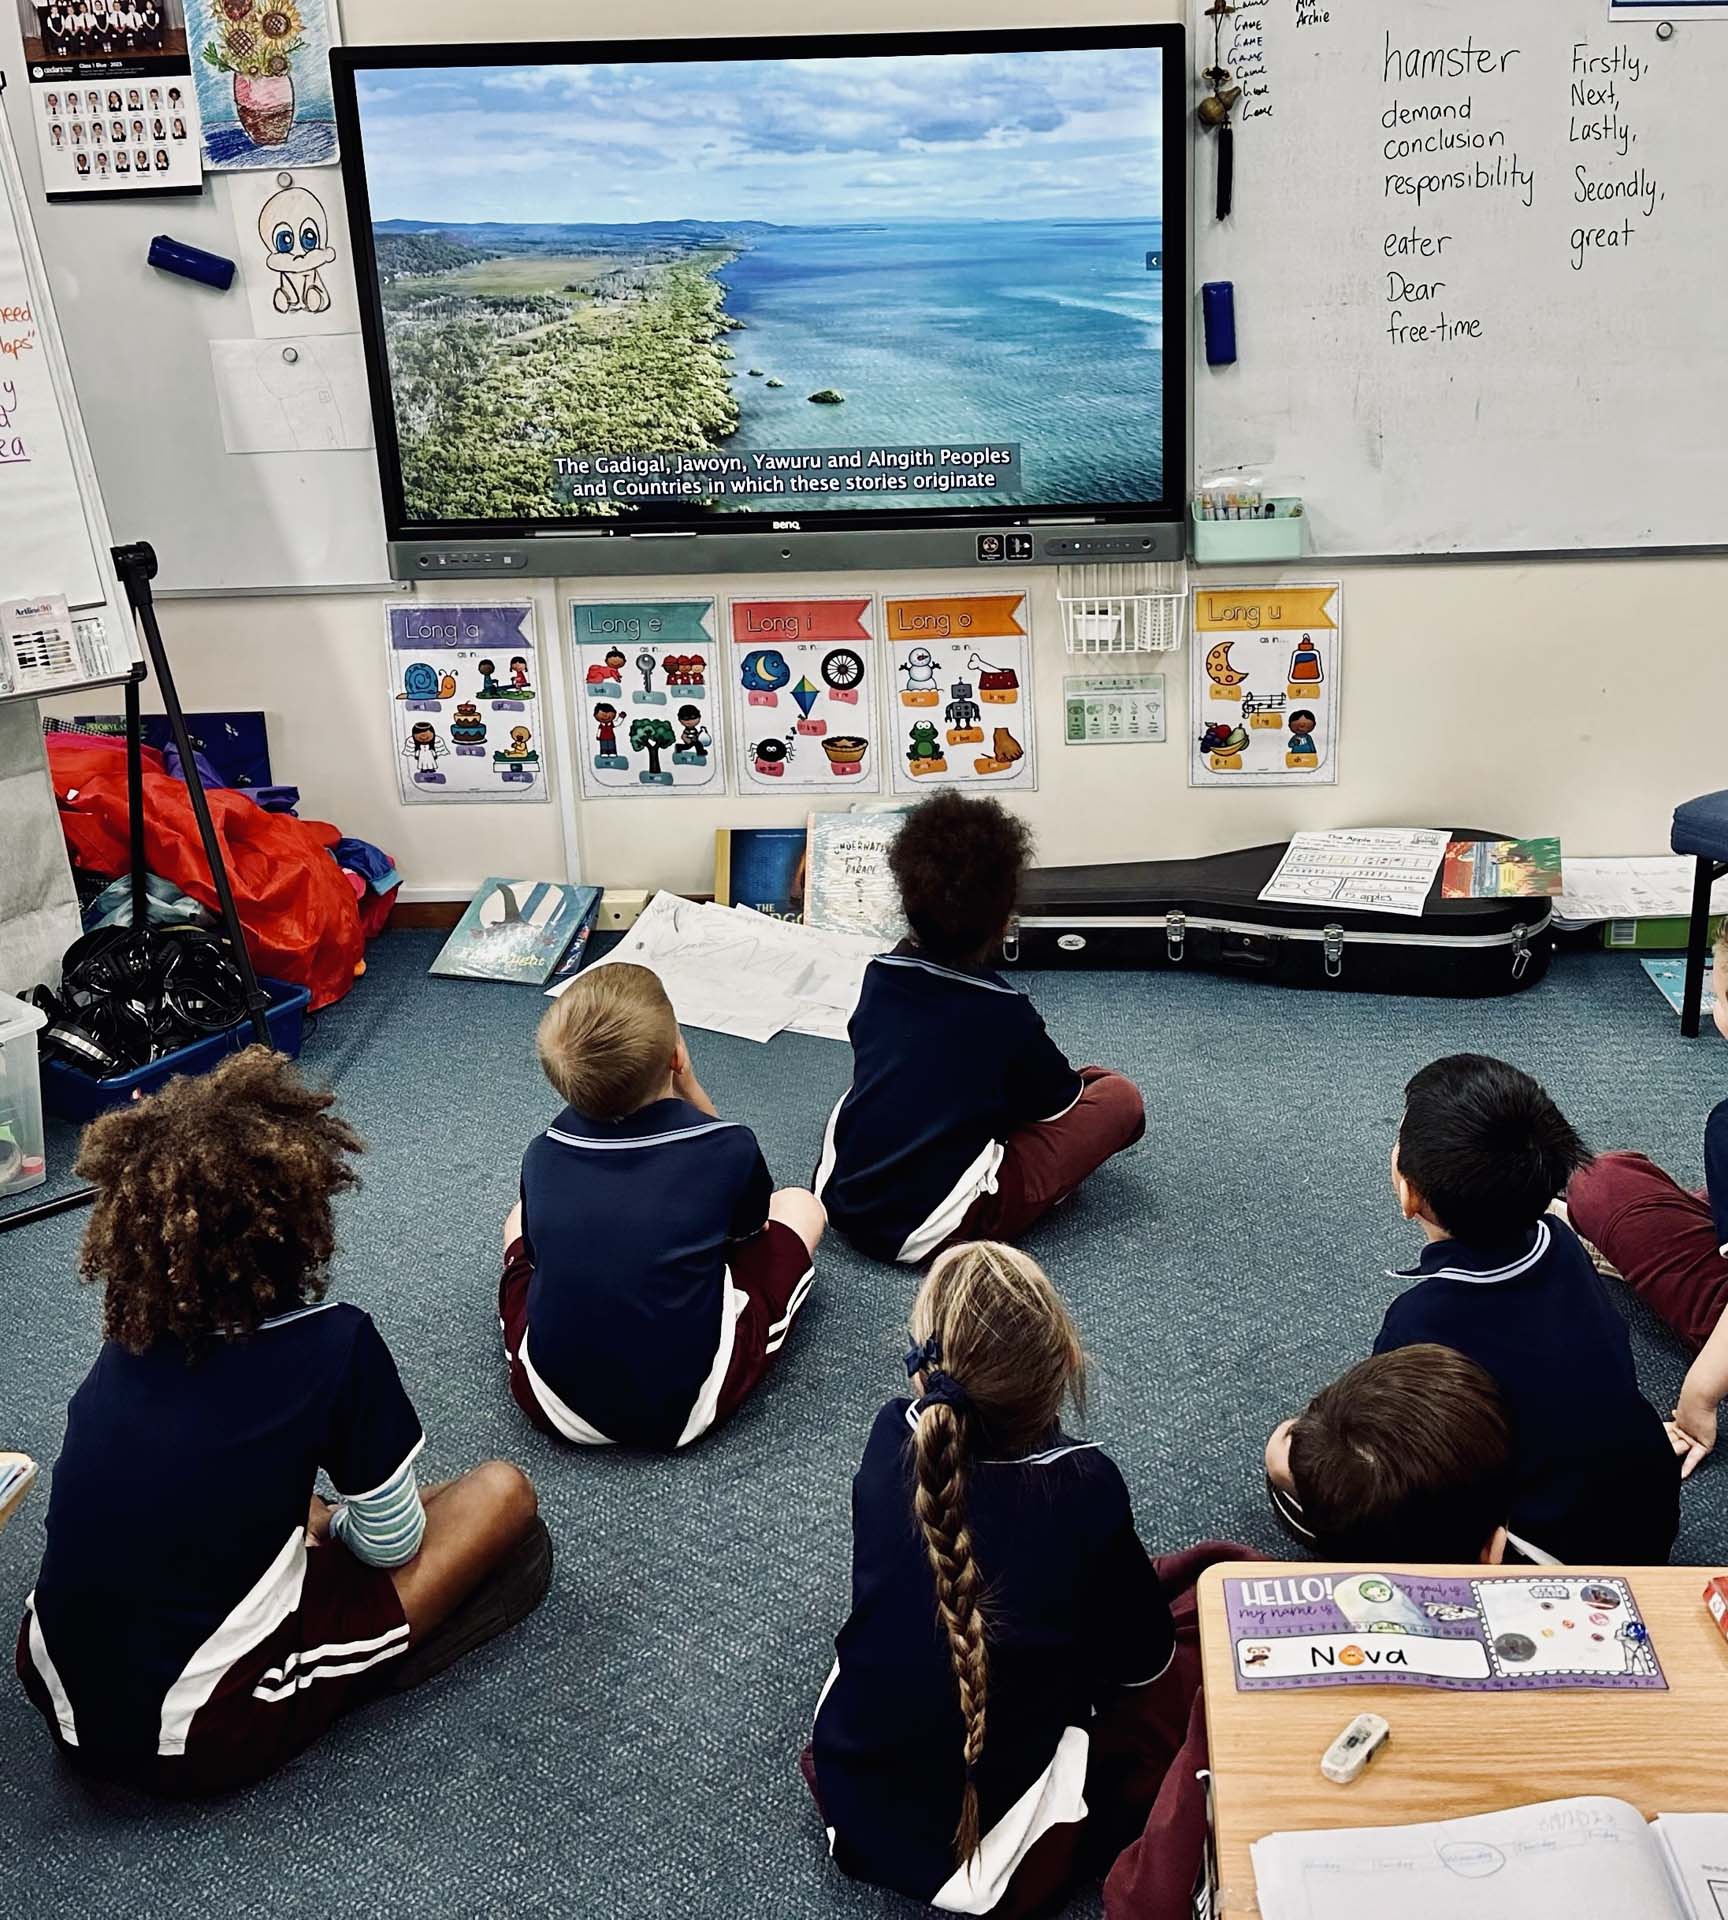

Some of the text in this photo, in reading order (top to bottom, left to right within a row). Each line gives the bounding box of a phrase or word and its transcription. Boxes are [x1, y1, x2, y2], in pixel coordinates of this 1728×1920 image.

[1296, 9, 1330, 28] Archie
[1384, 30, 1521, 82] hamster
[1572, 44, 1648, 81] Firstly,
[1571, 80, 1619, 110] Next,
[1382, 96, 1471, 128] demand
[1384, 128, 1504, 159] conclusion
[1570, 114, 1637, 155] Lastly,
[1385, 153, 1533, 207] responsibility
[1574, 165, 1665, 216] Secondly,
[1384, 226, 1452, 256] eater
[1570, 218, 1635, 270] great
[1387, 271, 1446, 302] Dear
[1387, 310, 1483, 344] free-time
[553, 447, 1010, 477] The Gadigal, Jawoyn, Yawuru and Alngith Peoples
[573, 471, 996, 497] and Countries in which these stories originate
[588, 609, 662, 640] Long e
[747, 609, 811, 639] Long i
[898, 608, 972, 636] Long o
[1208, 598, 1281, 628] Long u
[405, 616, 479, 646] Long a
[755, 903, 775, 912] THE
[1240, 1577, 1333, 1606] HELLO!
[1239, 1609, 1267, 1624] my
[1271, 1606, 1317, 1618] name
